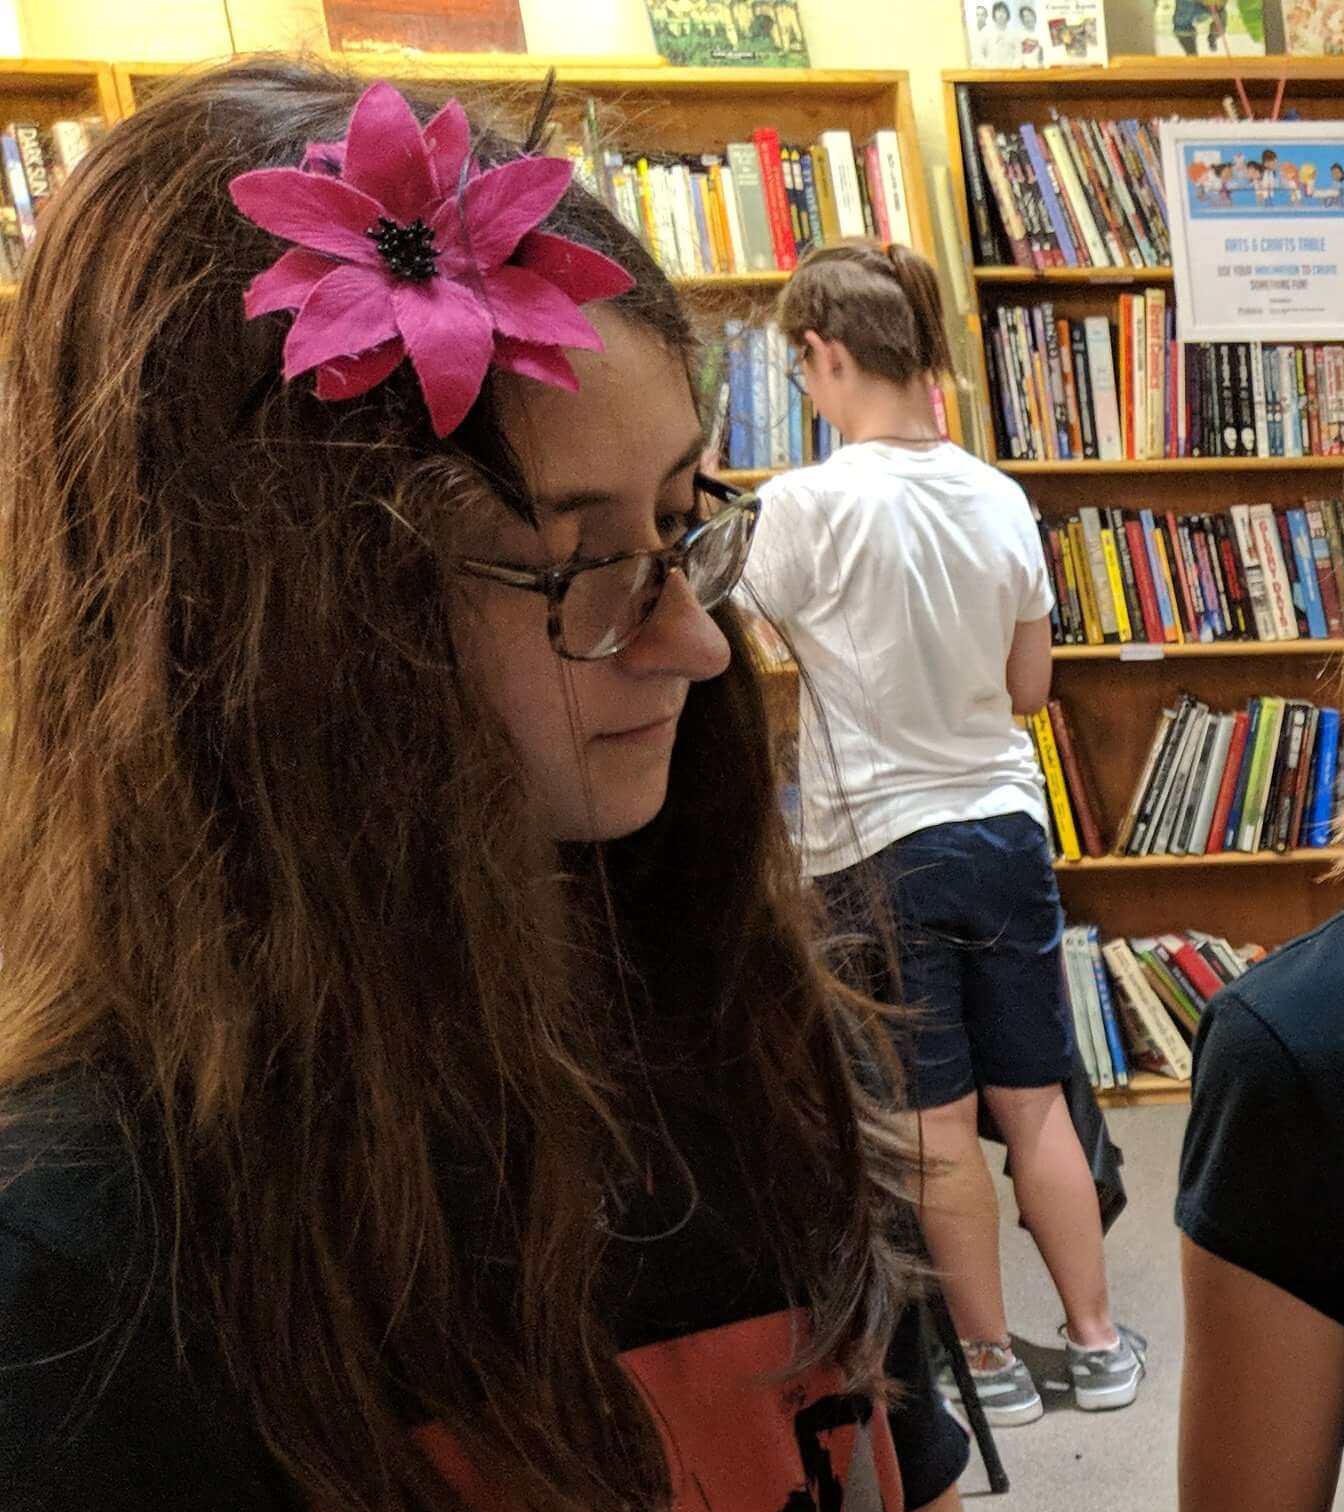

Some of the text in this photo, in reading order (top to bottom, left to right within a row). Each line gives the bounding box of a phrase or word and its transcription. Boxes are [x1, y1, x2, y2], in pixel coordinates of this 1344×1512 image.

[1225, 237, 1249, 252] ARTS
[1260, 237, 1296, 252] CRAFTS
[1298, 237, 1327, 252] TABLE
